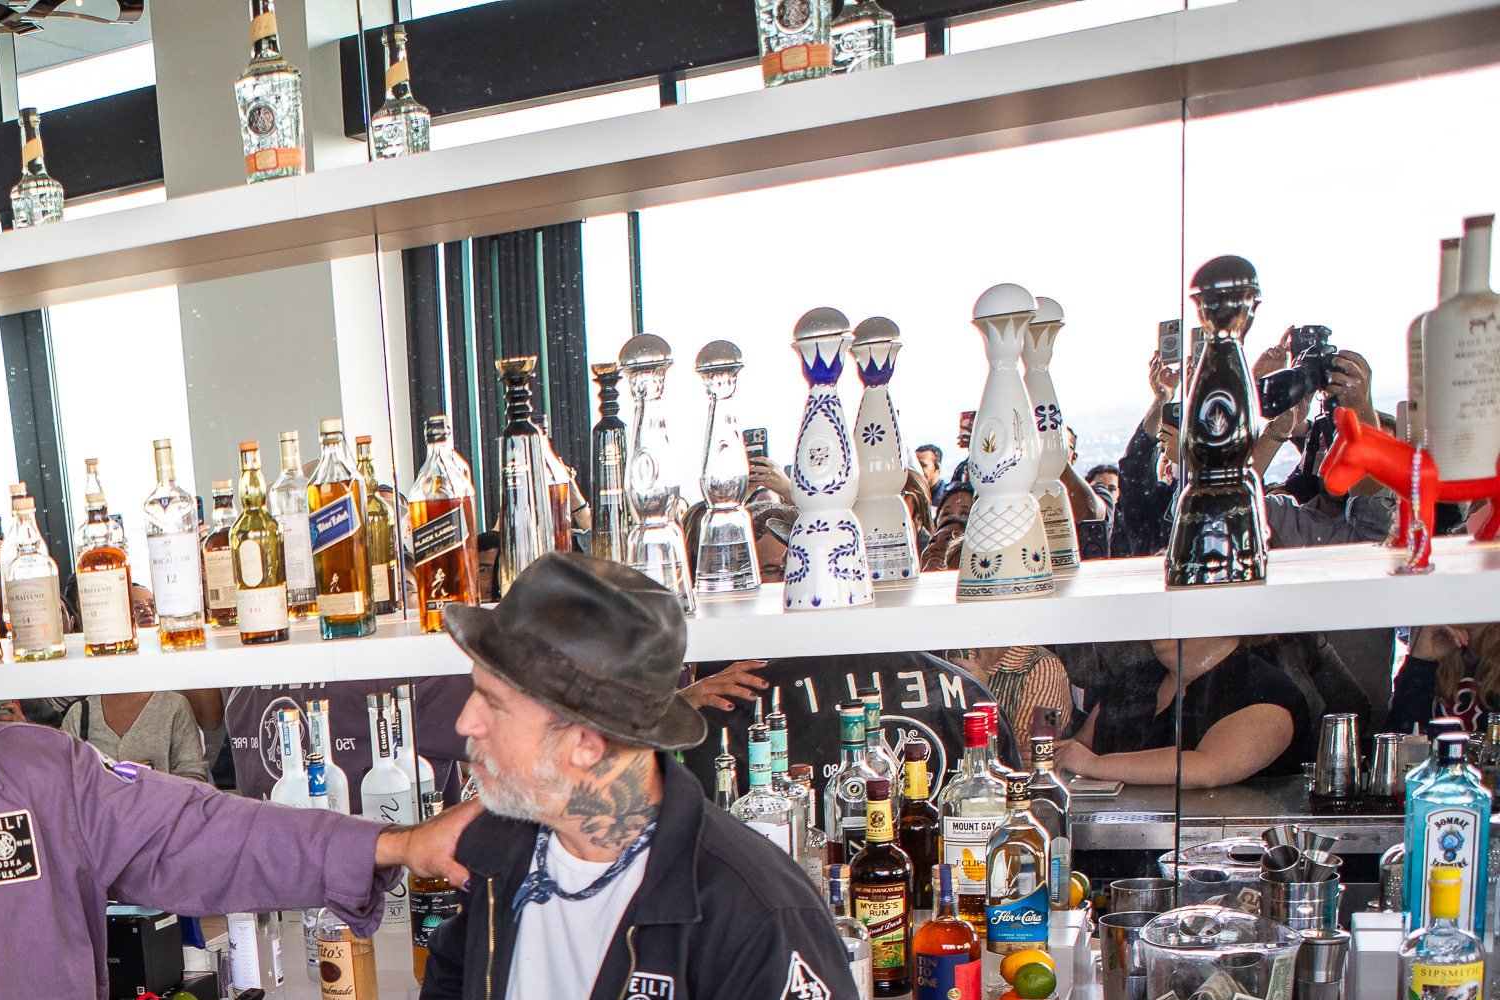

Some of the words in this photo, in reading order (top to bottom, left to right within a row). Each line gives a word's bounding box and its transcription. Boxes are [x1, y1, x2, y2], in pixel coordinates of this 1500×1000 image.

[434, 524, 458, 538] LABEL
[152, 555, 190, 566] MACALLAN
[166, 574, 177, 584] 12
[436, 601, 445, 609] 12
[380, 720, 388, 750] CHOPIN
[952, 821, 980, 831] MOUNT
[981, 821, 997, 830] GAY
[1434, 817, 1470, 831] BOMBAY
[956, 859, 986, 867] ECLIPS
[1, 870, 16, 879] U.S.
[860, 901, 900, 910] MYERS'S
[869, 909, 889, 917] RUM
[991, 909, 1015, 925] Flor
[1014, 913, 1022, 921] de
[1021, 909, 1043, 925] Caña
[884, 917, 903, 931] Dark
[917, 956, 937, 968] TEN
[917, 966, 932, 977] TO
[1421, 966, 1480, 978] SIPSMITH
[628, 977, 667, 997] EILI
[917, 976, 938, 988] ONE
